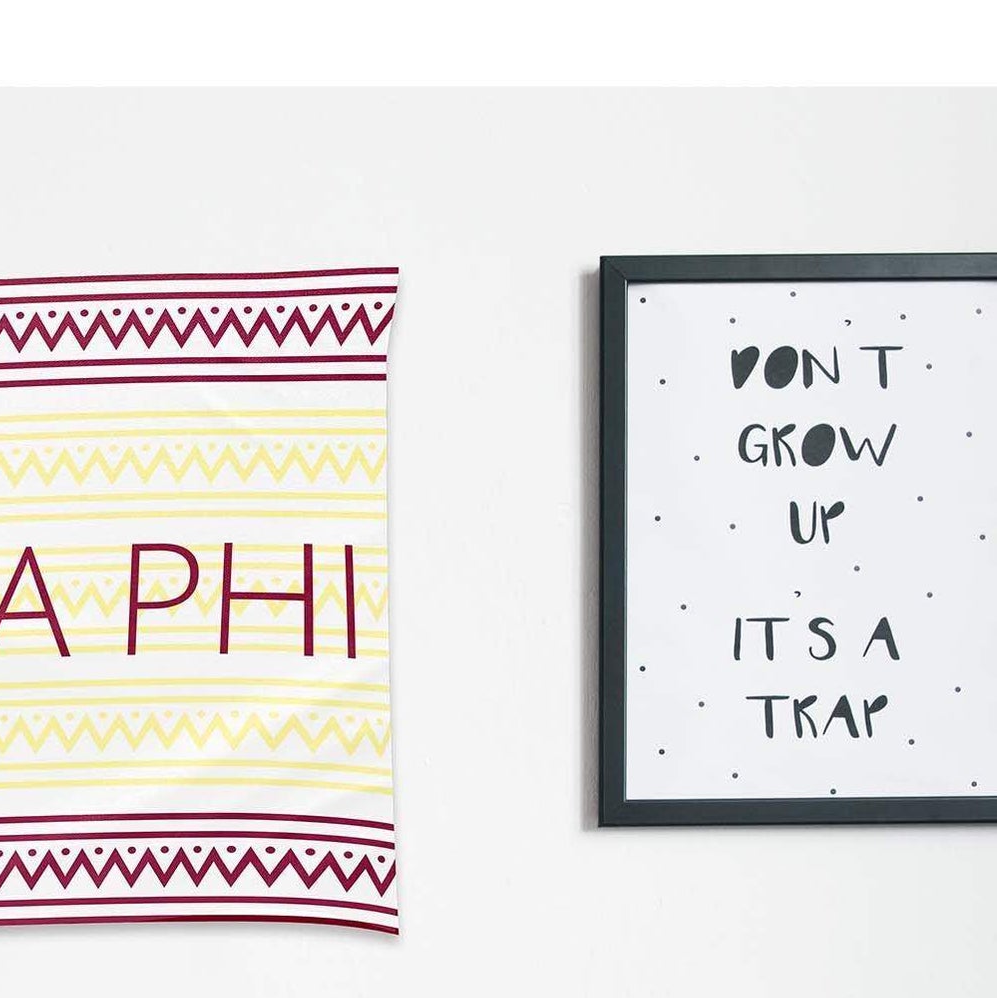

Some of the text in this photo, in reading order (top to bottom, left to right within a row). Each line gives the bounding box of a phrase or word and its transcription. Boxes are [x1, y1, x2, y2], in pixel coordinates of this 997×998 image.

[731, 318, 903, 389] DON'T
[739, 424, 896, 466] GROW
[790, 502, 844, 544] UP
[128, 543, 356, 659] PHI
[734, 590, 899, 660] IT'S A
[746, 695, 887, 738] TRAP
